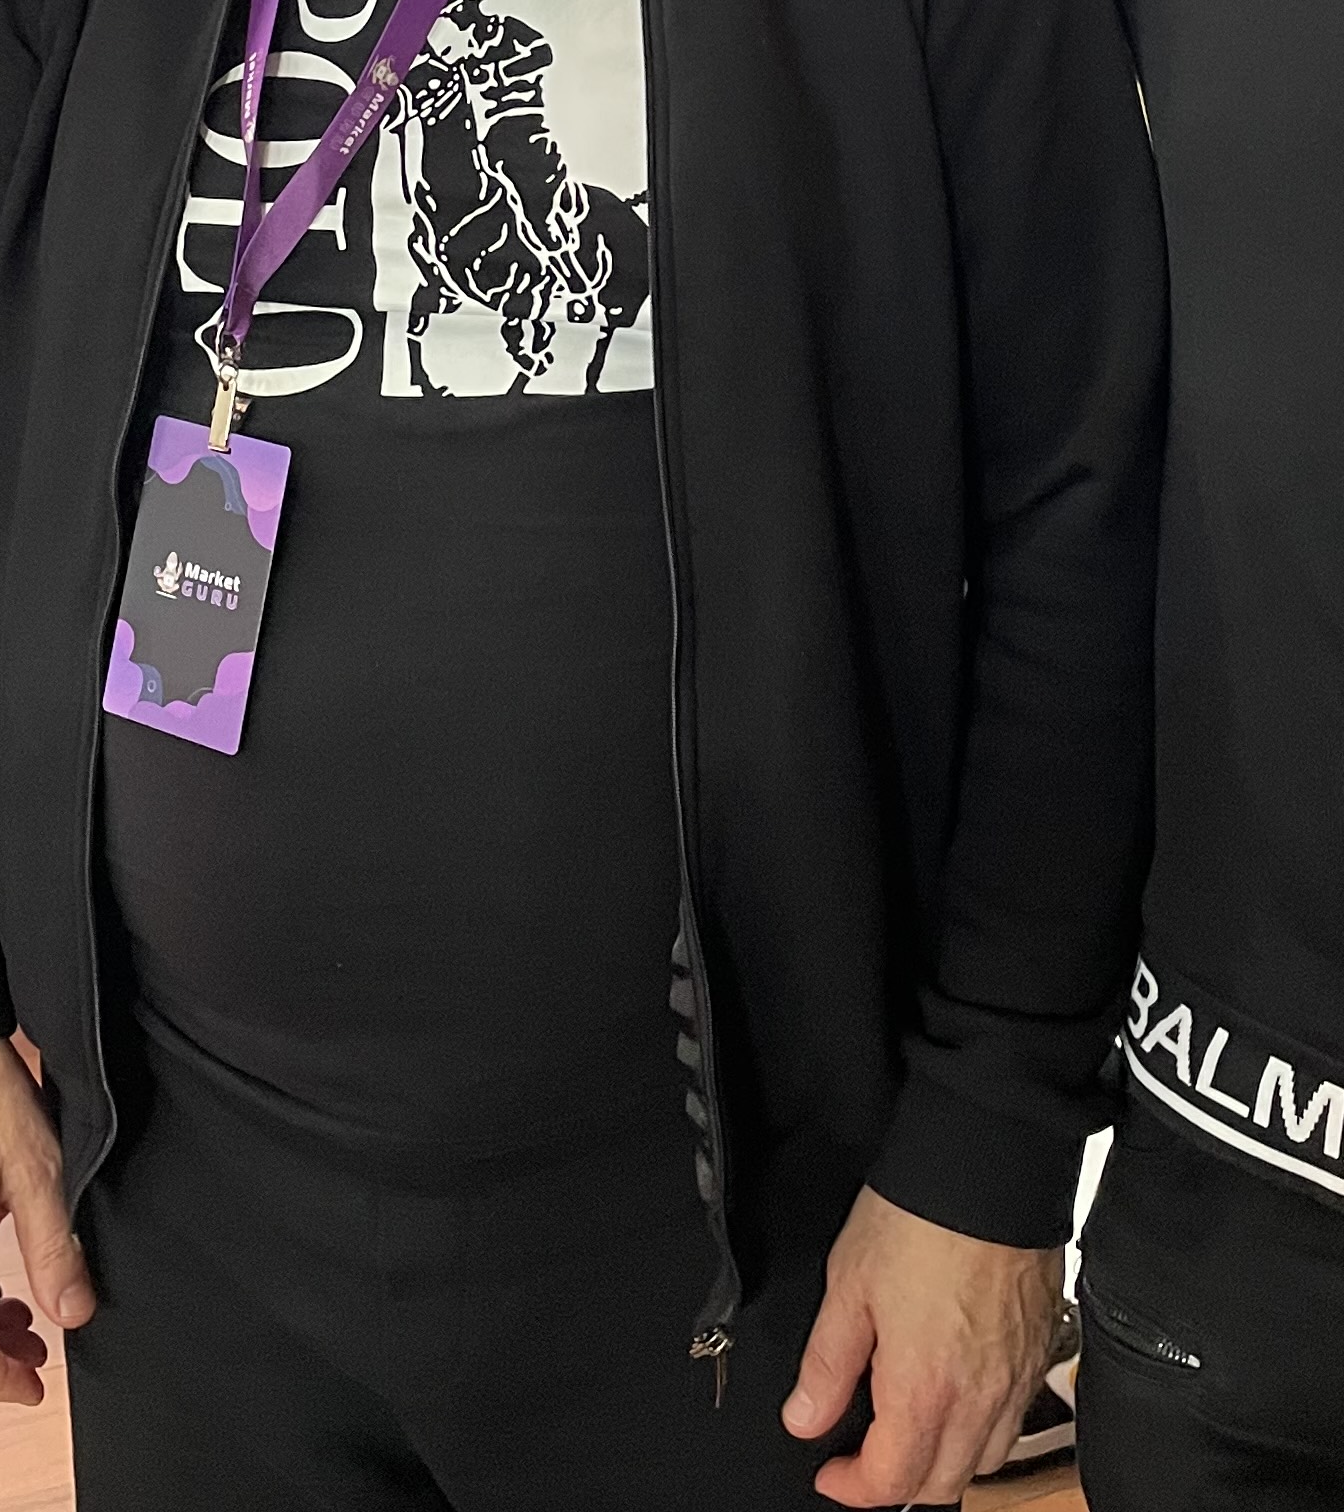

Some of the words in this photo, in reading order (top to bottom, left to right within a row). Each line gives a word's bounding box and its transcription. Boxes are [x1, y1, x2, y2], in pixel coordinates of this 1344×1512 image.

[338, 92, 385, 156] Market
[184, 561, 241, 593] Market
[180, 579, 239, 611] GURU
